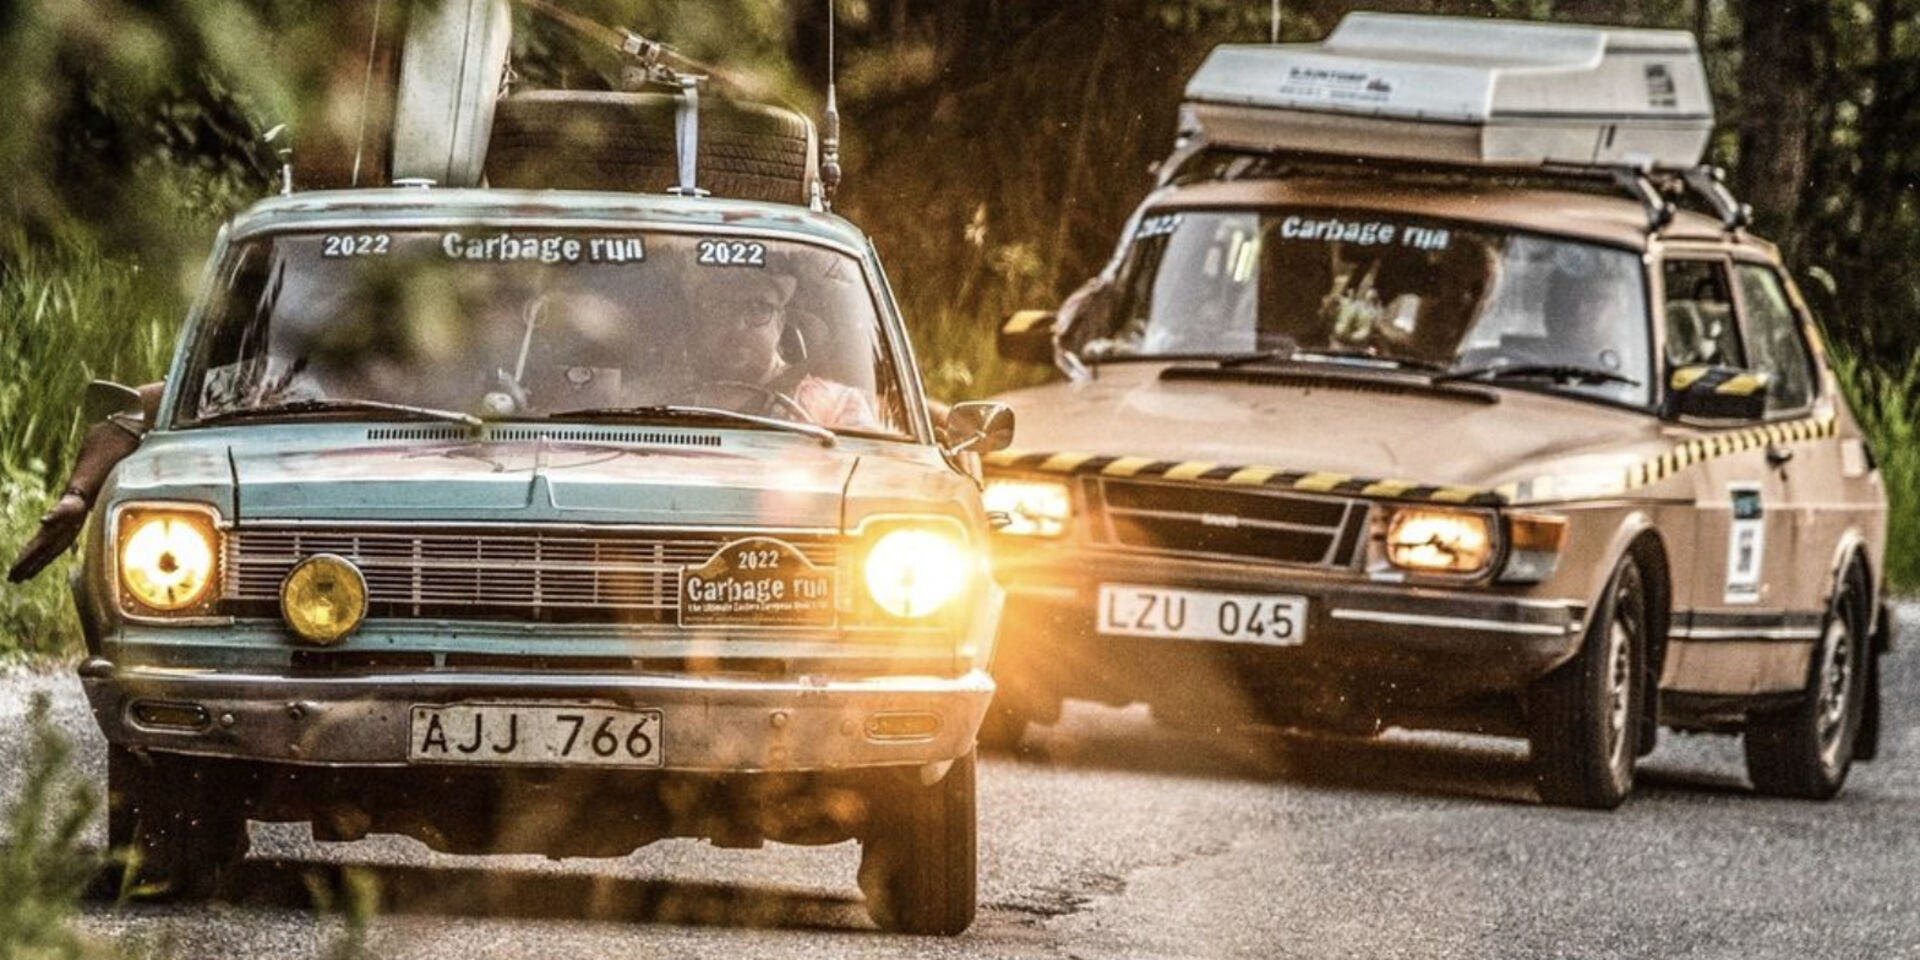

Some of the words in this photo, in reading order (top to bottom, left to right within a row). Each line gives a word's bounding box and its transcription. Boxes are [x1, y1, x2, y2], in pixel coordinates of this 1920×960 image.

[323, 234, 391, 256] 2022
[1281, 216, 1394, 244] Carbage
[1403, 226, 1449, 249] run
[442, 232, 582, 263] Carbage
[590, 237, 645, 260] run
[699, 241, 765, 265] 2022
[738, 550, 779, 569] 2022
[687, 577, 785, 602] Carbage
[793, 577, 829, 598] run
[1107, 592, 1186, 631] LZU
[1218, 600, 1294, 638] 045
[421, 713, 518, 753] AJJ
[556, 714, 652, 758] 766
